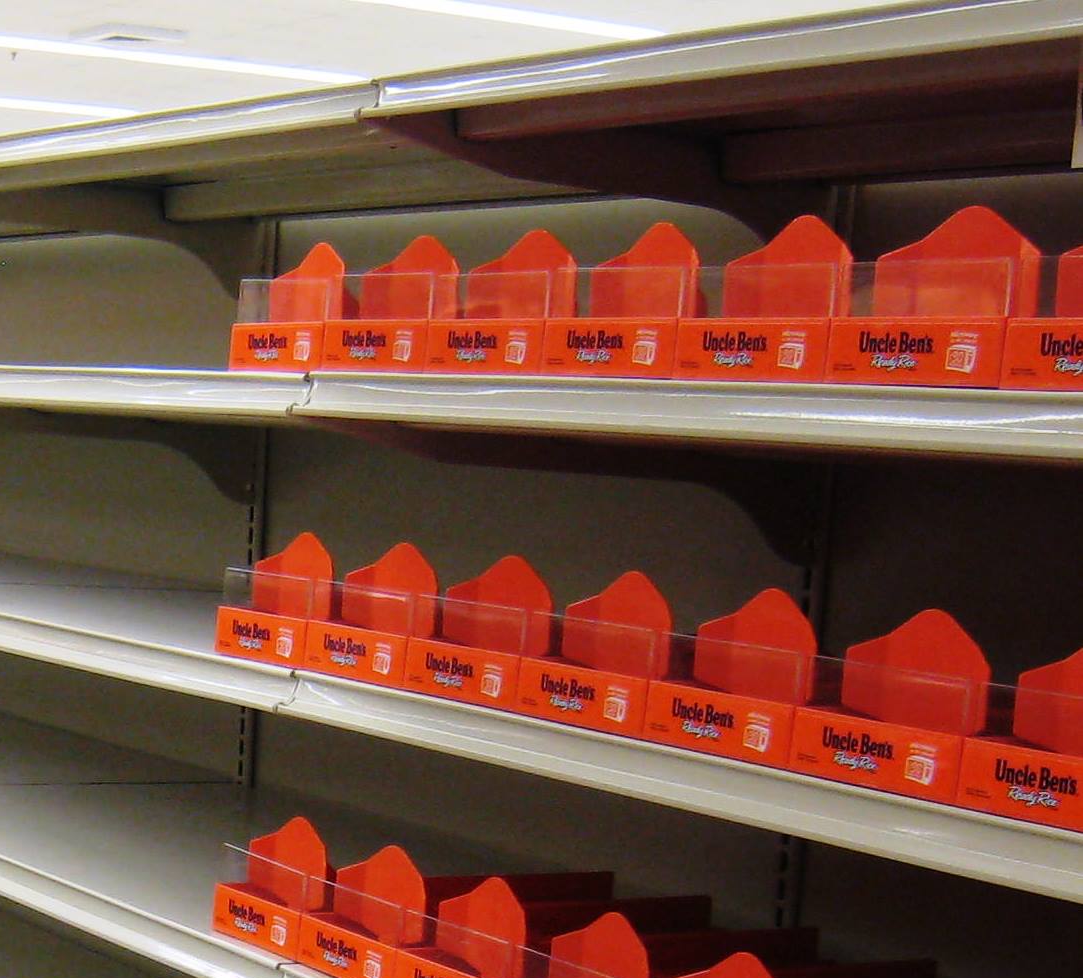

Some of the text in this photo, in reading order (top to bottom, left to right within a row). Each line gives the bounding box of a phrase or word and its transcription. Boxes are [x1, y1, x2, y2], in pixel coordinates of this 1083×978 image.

[343, 330, 365, 348] Uncle
[448, 331, 473, 350] Uncle
[567, 331, 596, 350] Uncle
[703, 331, 736, 352] Uncle
[736, 331, 767, 351] Ben's
[859, 331, 897, 353] Uncle
[897, 331, 934, 353] Ben's
[1041, 332, 1083, 356] Uncle
[324, 634, 346, 654] Uncle
[425, 653, 450, 674] Uncle
[541, 674, 568, 696] Uncle
[672, 698, 704, 722] Uncle
[704, 704, 735, 729] Ben's
[823, 726, 859, 752] Uncle
[859, 733, 894, 760] Ben's
[995, 759, 1078, 795] Uncle Ben's
[316, 931, 338, 952] Uncle
